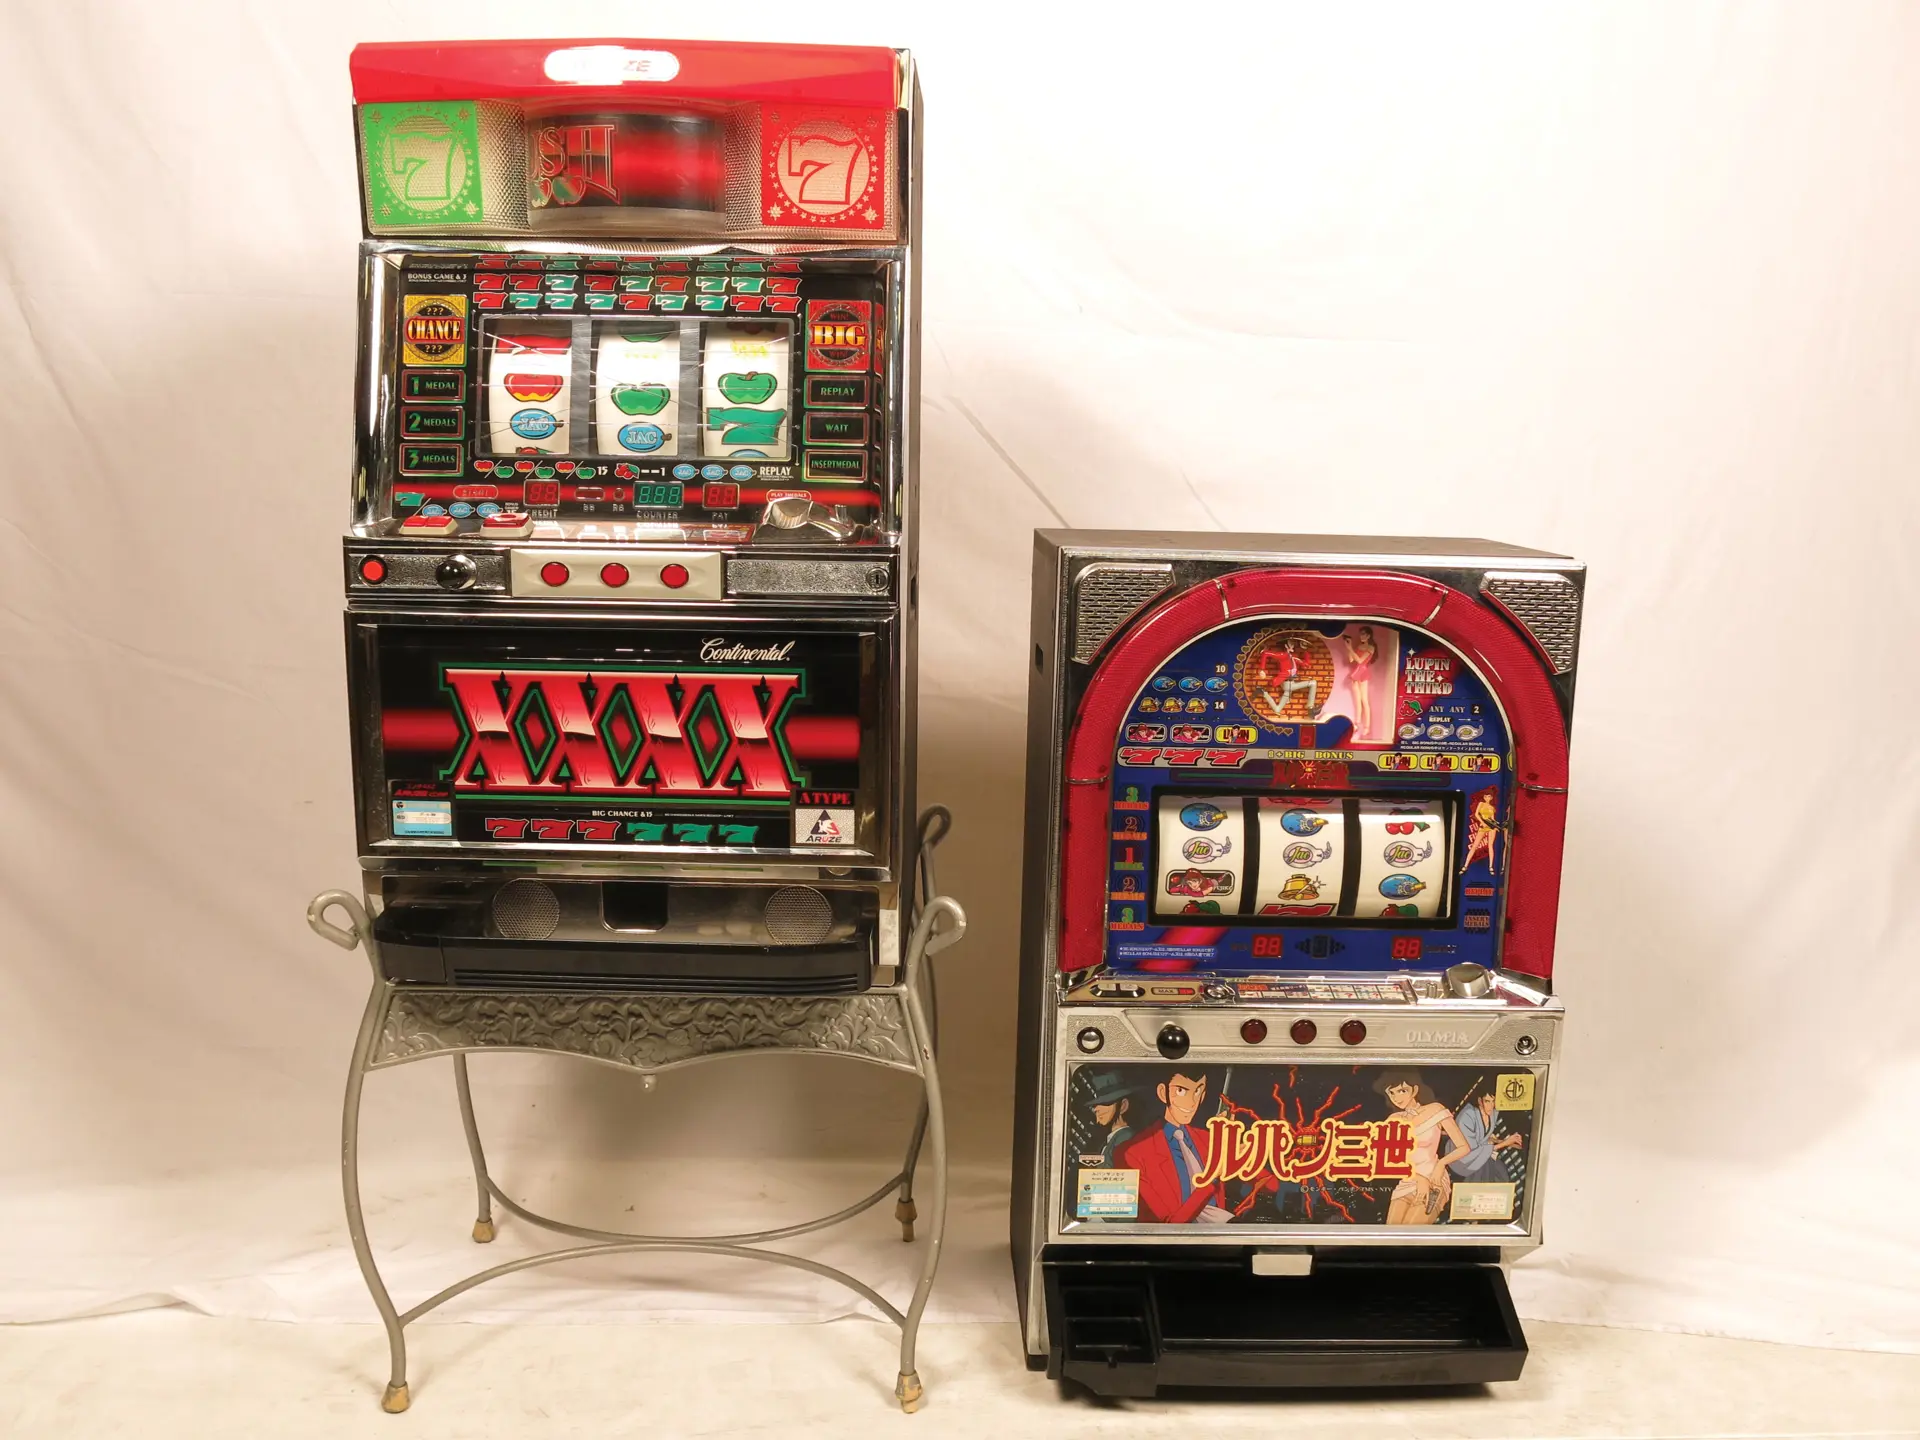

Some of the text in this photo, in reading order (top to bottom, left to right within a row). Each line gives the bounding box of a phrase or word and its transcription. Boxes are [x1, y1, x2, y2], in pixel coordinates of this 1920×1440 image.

[407, 319, 461, 340] CHANCE
[812, 325, 866, 346] BIG
[425, 381, 457, 390] MEDAL
[820, 386, 856, 397] REPLAY
[408, 412, 457, 432] 2 MEDALS
[825, 423, 849, 433] WAIT
[626, 430, 658, 445] JAC
[422, 454, 456, 463] MEDALS
[597, 466, 608, 476] 15
[760, 466, 792, 476] REPLAY
[1215, 665, 1226, 673] 10
[1405, 657, 1451, 671] LUPIN
[1405, 670, 1436, 683] THE
[1405, 681, 1453, 695] THIRD
[1214, 702, 1225, 710] 14
[1428, 705, 1480, 714] ANY ANY 2
[1315, 751, 1354, 759] BONUS
[812, 792, 851, 805] TYPE
[607, 810, 638, 818] CHANCE
[805, 835, 843, 843] ARUZE
[1406, 1029, 1470, 1044] OLYMPIA
